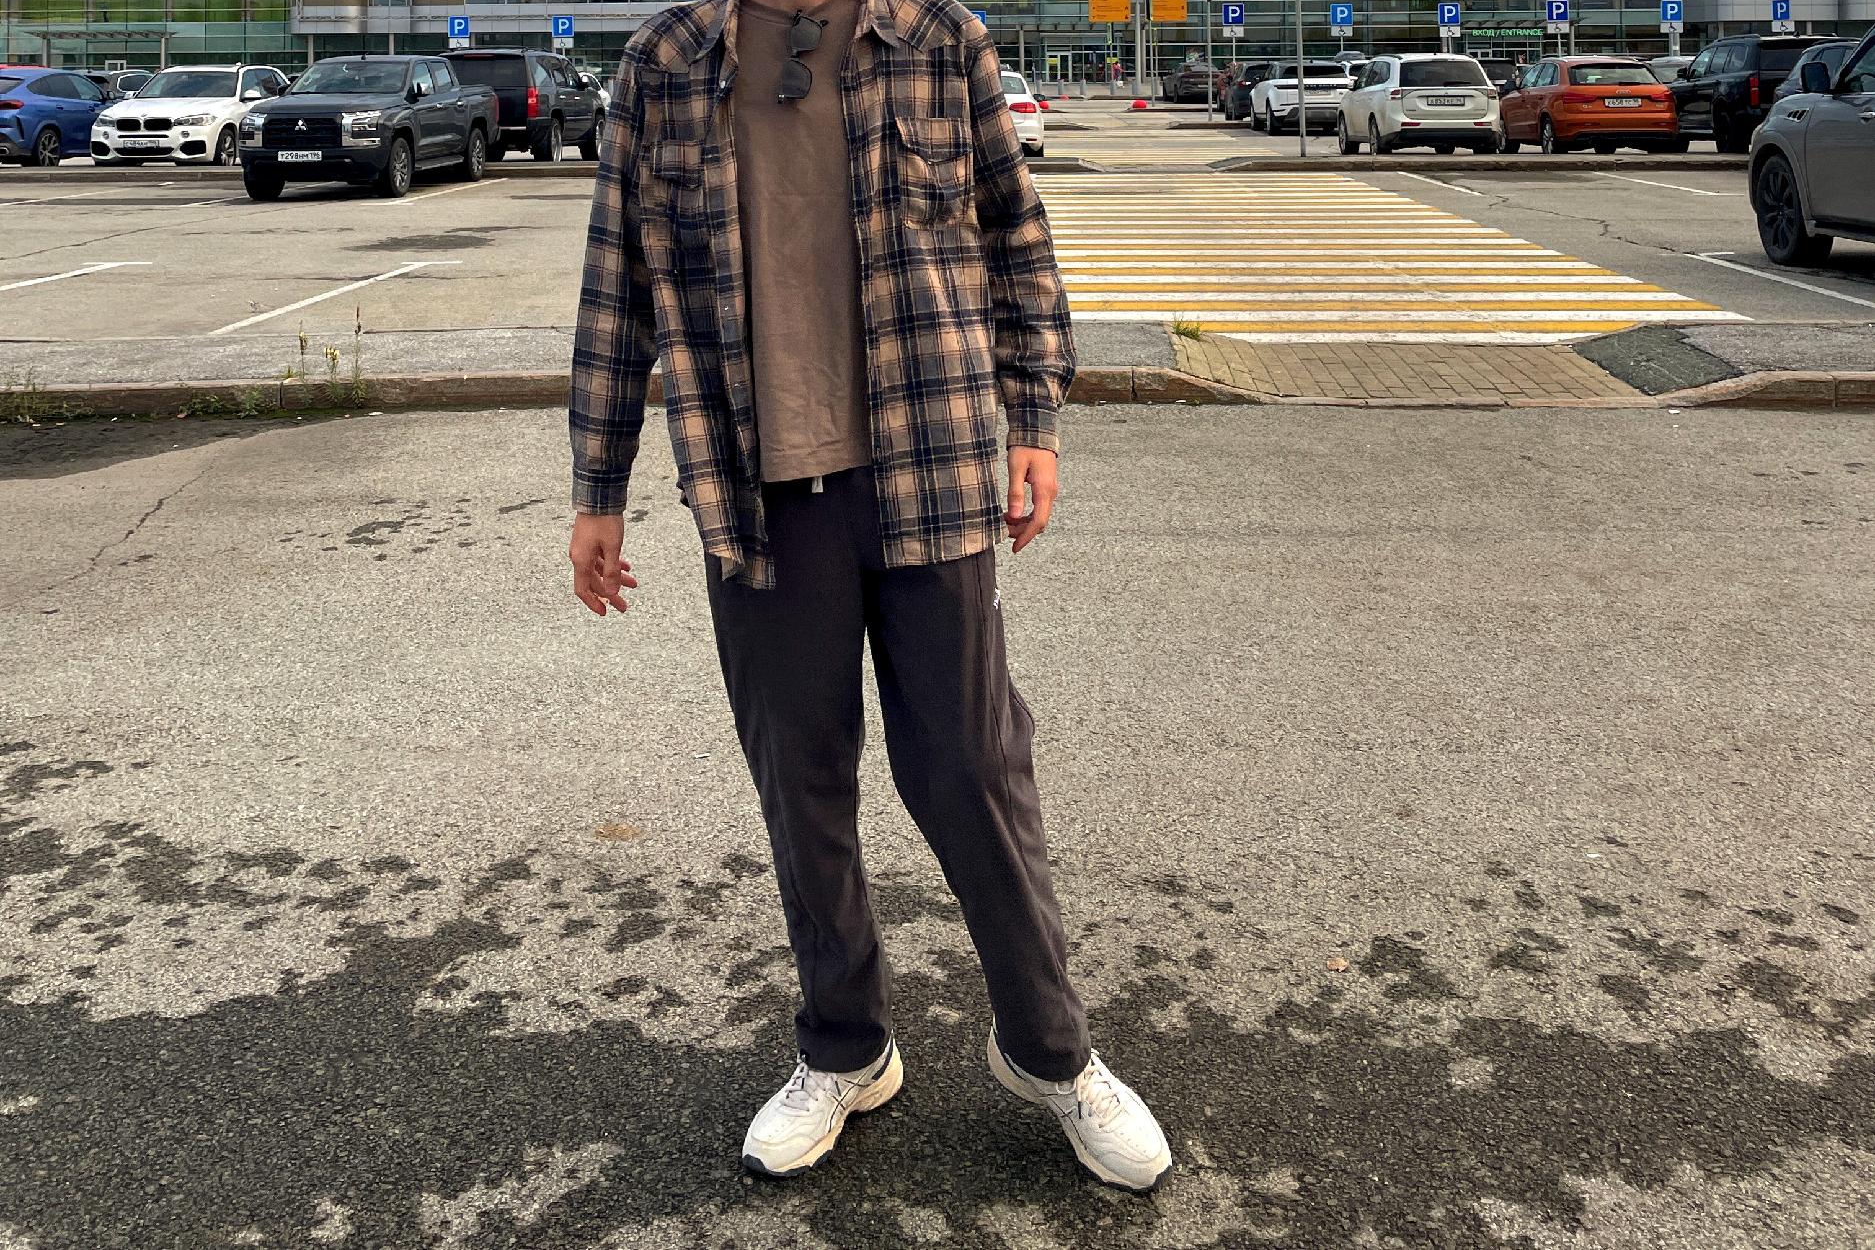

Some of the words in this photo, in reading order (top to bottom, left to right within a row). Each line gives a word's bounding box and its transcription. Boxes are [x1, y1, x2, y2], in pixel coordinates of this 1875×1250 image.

[1228, 6, 1240, 22] P
[1336, 7, 1348, 22] P
[1444, 6, 1456, 22] P
[1552, 2, 1565, 19] P
[1666, 3, 1678, 19] P
[1777, 2, 1787, 18] P
[454, 19, 465, 34] P
[558, 19, 570, 34] P
[1472, 29, 1495, 37] ВХОД
